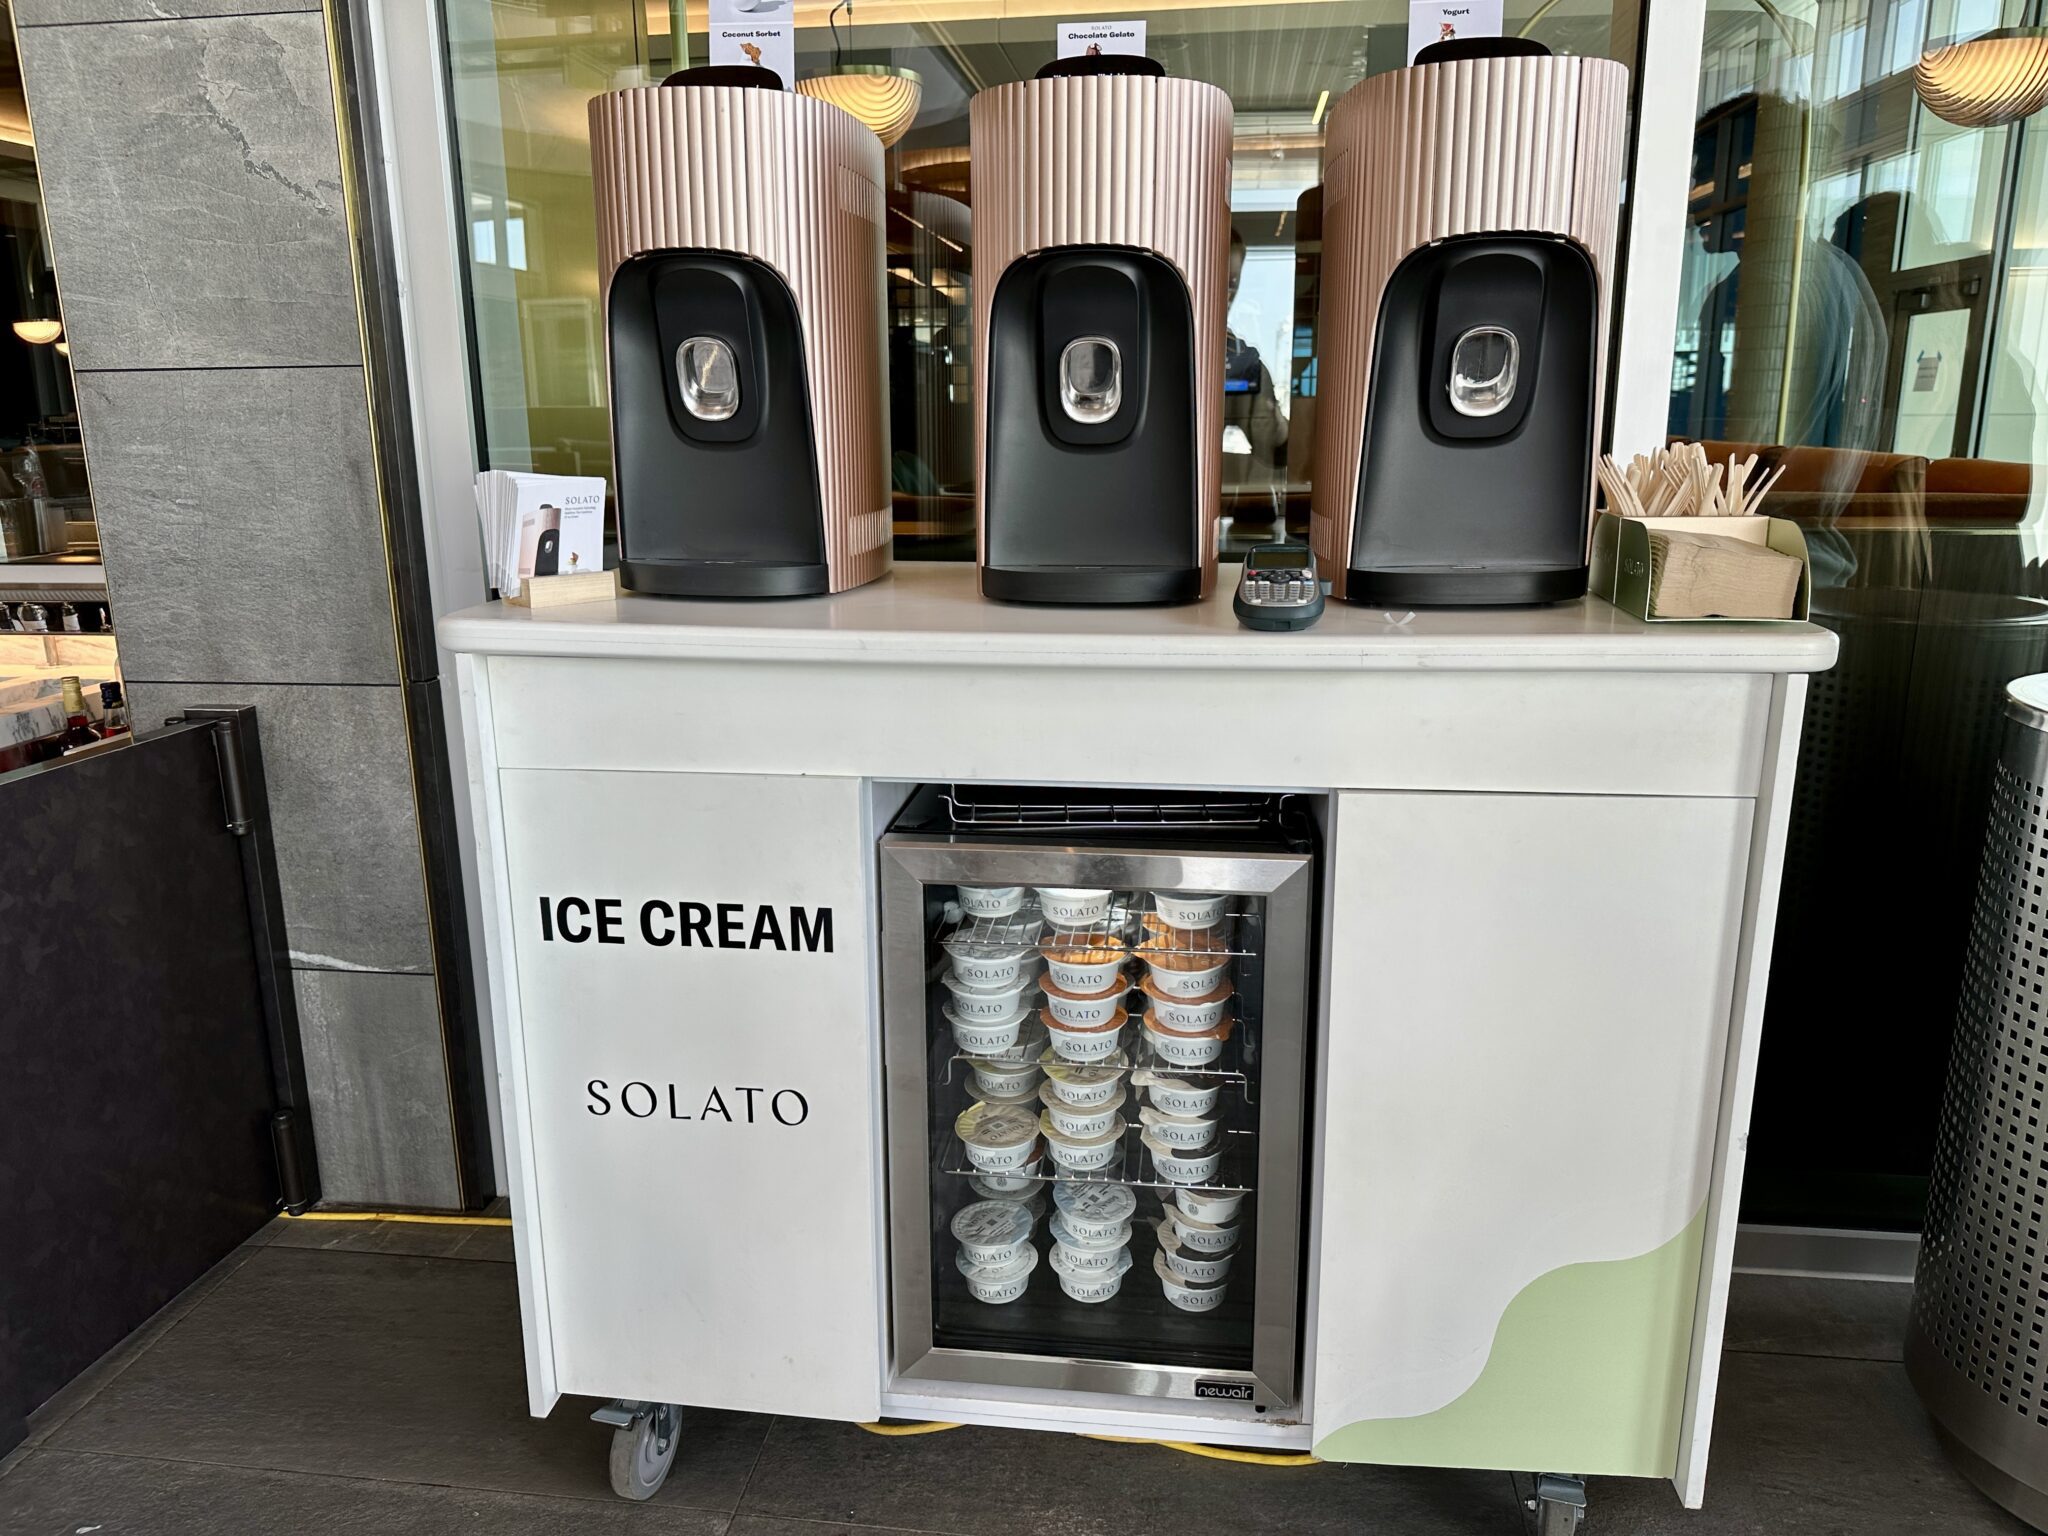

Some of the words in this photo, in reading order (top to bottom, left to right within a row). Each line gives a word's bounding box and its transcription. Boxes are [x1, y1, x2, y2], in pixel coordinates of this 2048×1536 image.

[1442, 8, 1470, 16] Yogurt
[1068, 32, 1108, 40] Chocolate
[565, 495, 600, 505] SOLATO
[1052, 905, 1099, 917] SOLATO
[539, 896, 625, 944] ICE
[639, 899, 834, 953] CREAM
[967, 966, 1014, 979] SOLATO
[1055, 971, 1102, 985] SOLATO
[1054, 1005, 1101, 1019] SOLATO
[1168, 1012, 1217, 1024] SOLATO
[963, 1033, 1010, 1046] SOLATO
[1065, 1039, 1112, 1052] SOLATO
[1164, 1044, 1213, 1057] SOLATO
[1060, 1088, 1107, 1101] SOLATO
[587, 1079, 809, 1126] SOLATO
[1164, 1096, 1212, 1109] SOLATO
[1059, 1119, 1106, 1132] SOLATO
[1162, 1129, 1210, 1142] SOLATO
[1058, 1150, 1104, 1164] SOLATO
[1161, 1161, 1210, 1176] SOLATO
[1072, 1224, 1117, 1238] SOLATO
[1190, 1233, 1236, 1246] SOLATO
[1064, 1251, 1108, 1267] SOLATO
[972, 1285, 1018, 1298] SOLATO
[1070, 1284, 1115, 1297] SOLATO
[1198, 1386, 1252, 1399] newair
